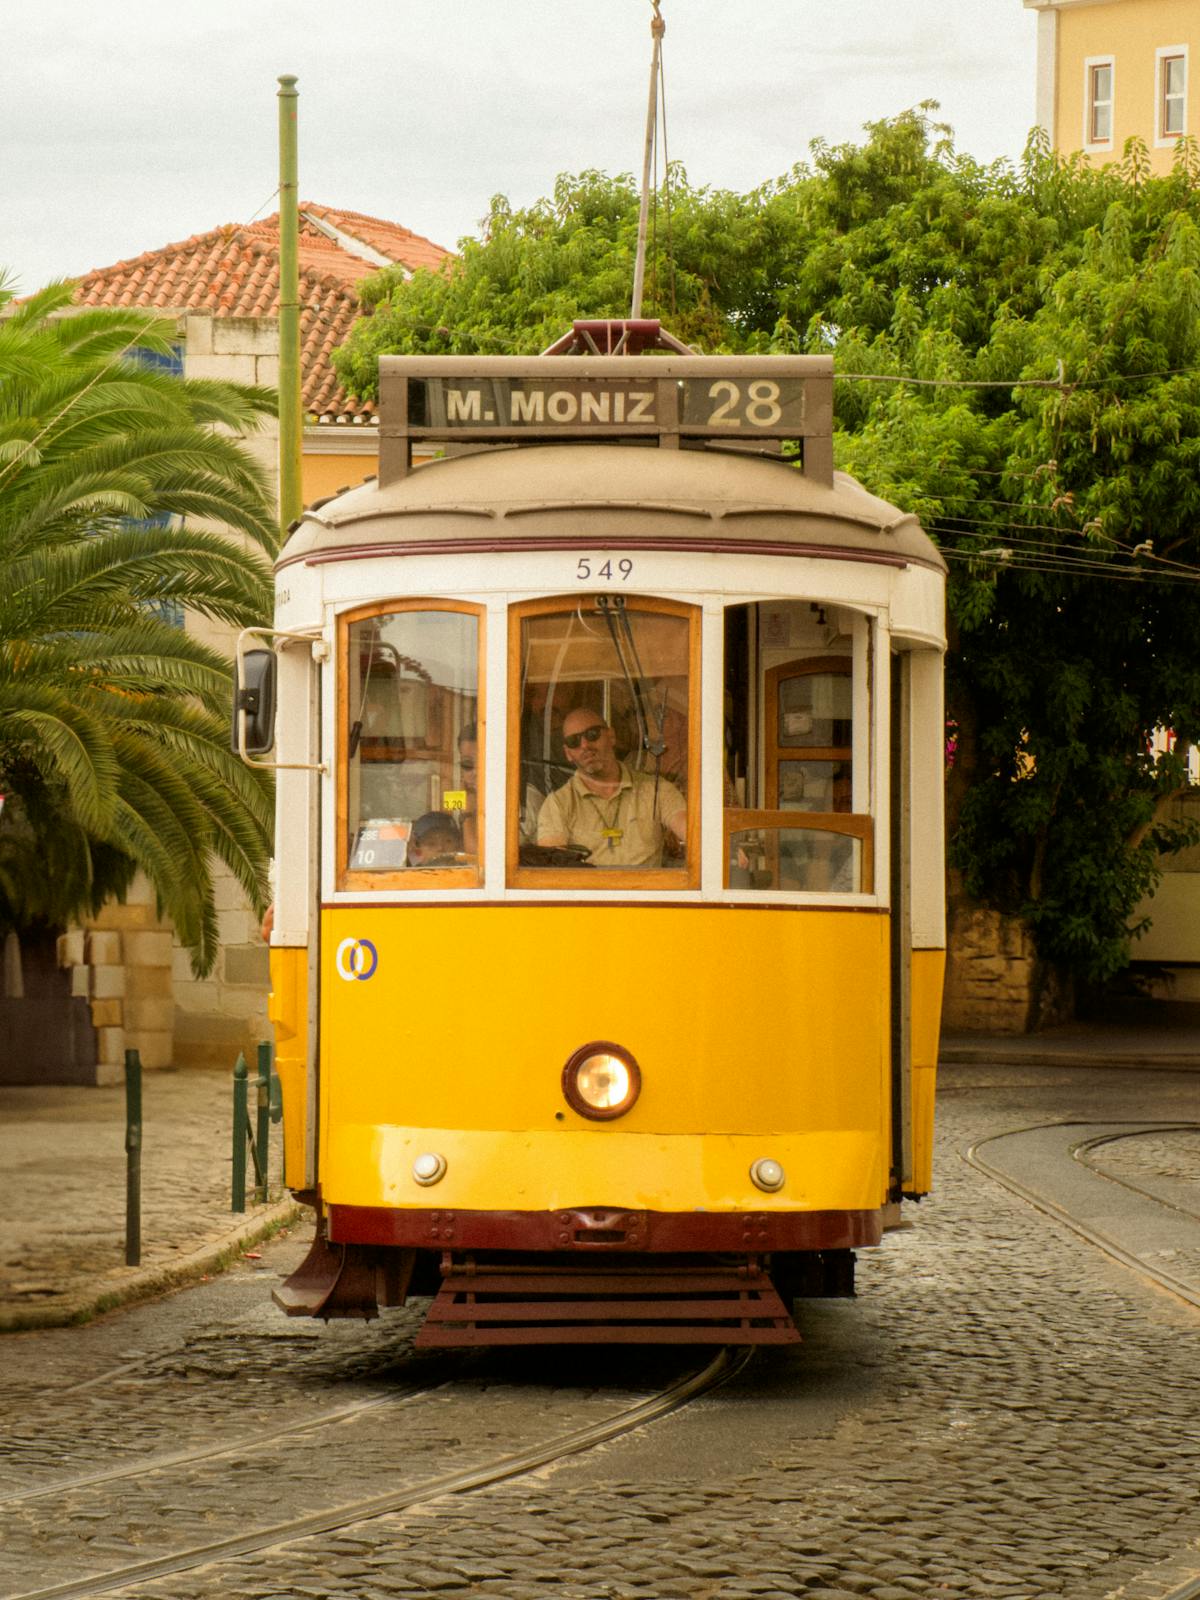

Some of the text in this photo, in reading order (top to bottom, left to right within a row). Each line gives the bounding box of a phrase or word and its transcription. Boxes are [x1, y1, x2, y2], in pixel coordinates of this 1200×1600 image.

[447, 389, 656, 423] M. MONIZ
[707, 380, 782, 427] 28
[576, 558, 633, 581] 549
